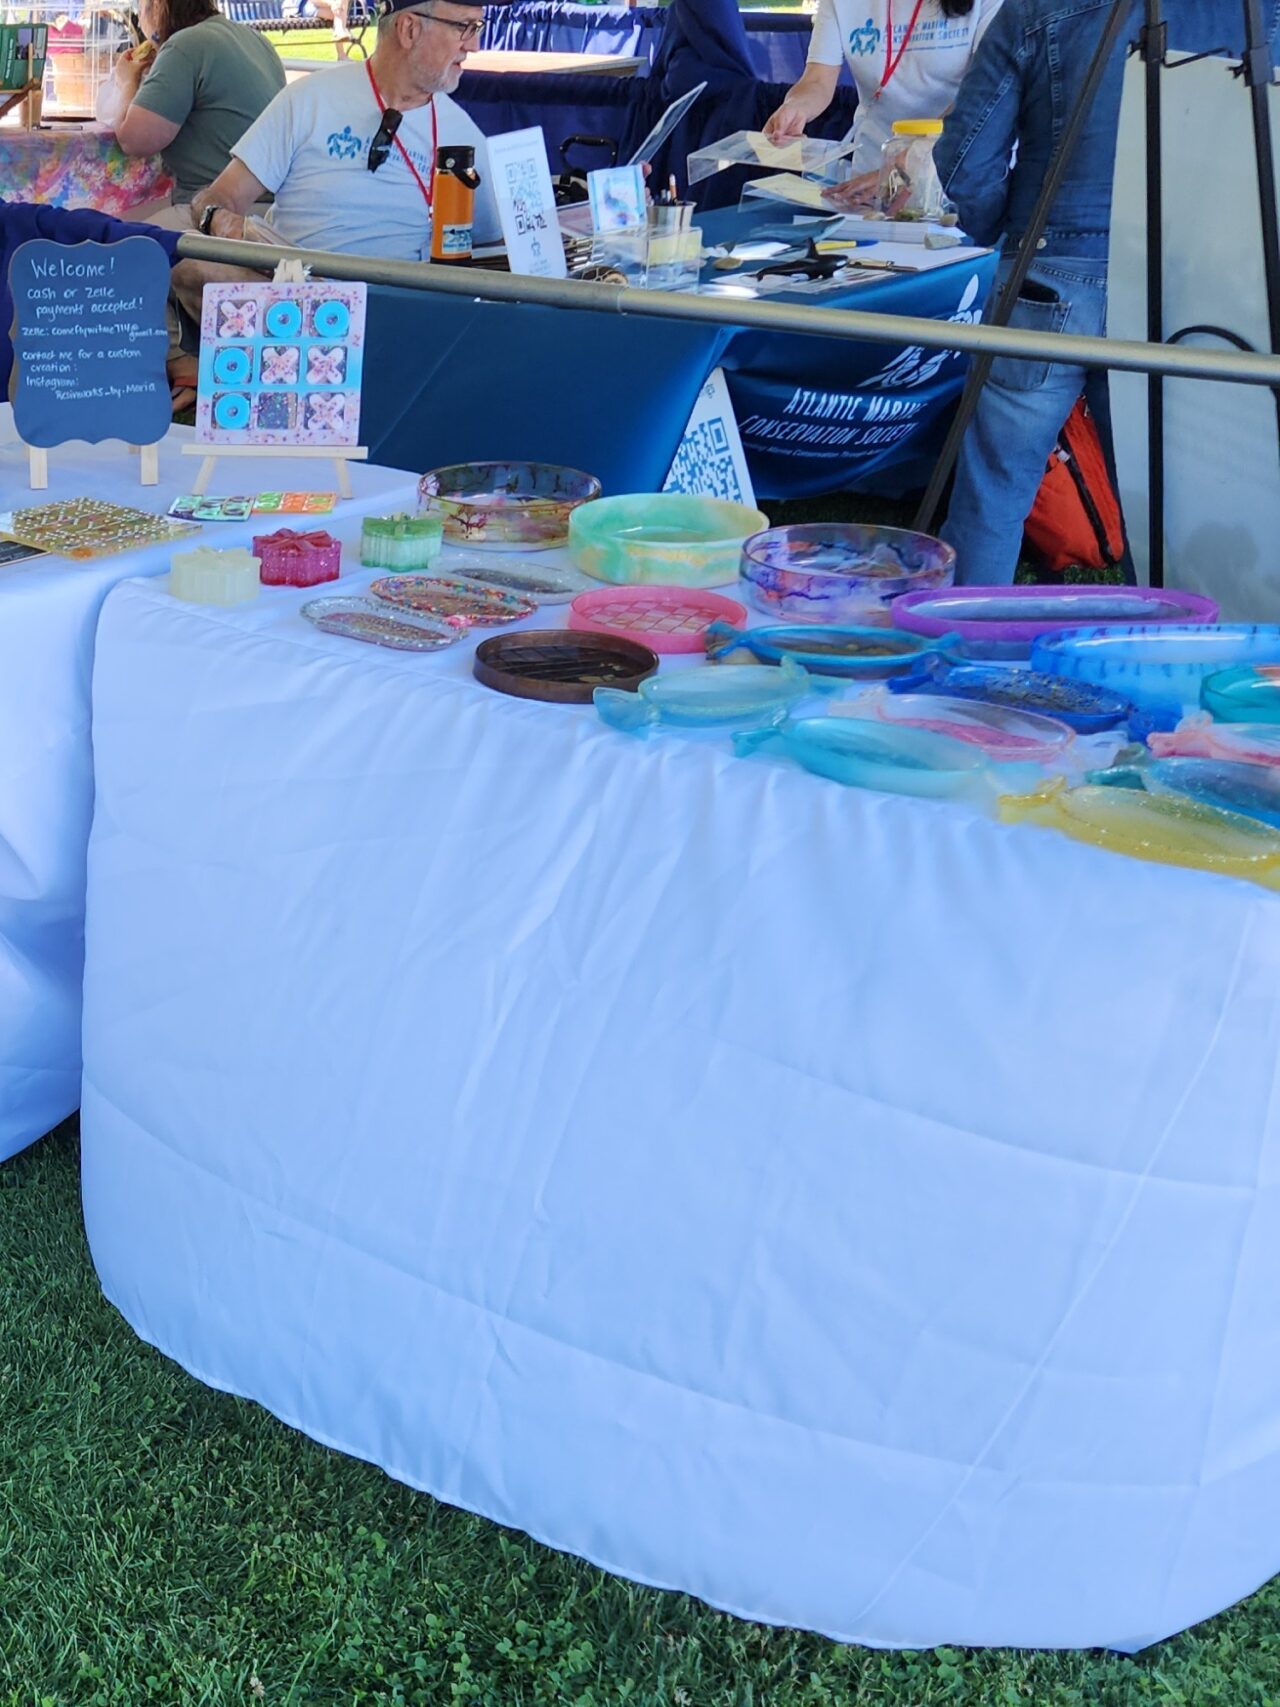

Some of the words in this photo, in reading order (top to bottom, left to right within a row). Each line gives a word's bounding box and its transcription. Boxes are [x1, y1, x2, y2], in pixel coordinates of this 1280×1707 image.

[31, 257, 114, 279] Welcome!
[27, 287, 56, 299] cash
[63, 288, 78, 299] or
[36, 304, 84, 323] payments
[22, 351, 56, 361] contact
[78, 349, 92, 360] for
[97, 351, 104, 359] a
[107, 348, 142, 359] custom
[782, 387, 863, 420] ATLANTIC
[738, 415, 860, 445] CONSERVATION
